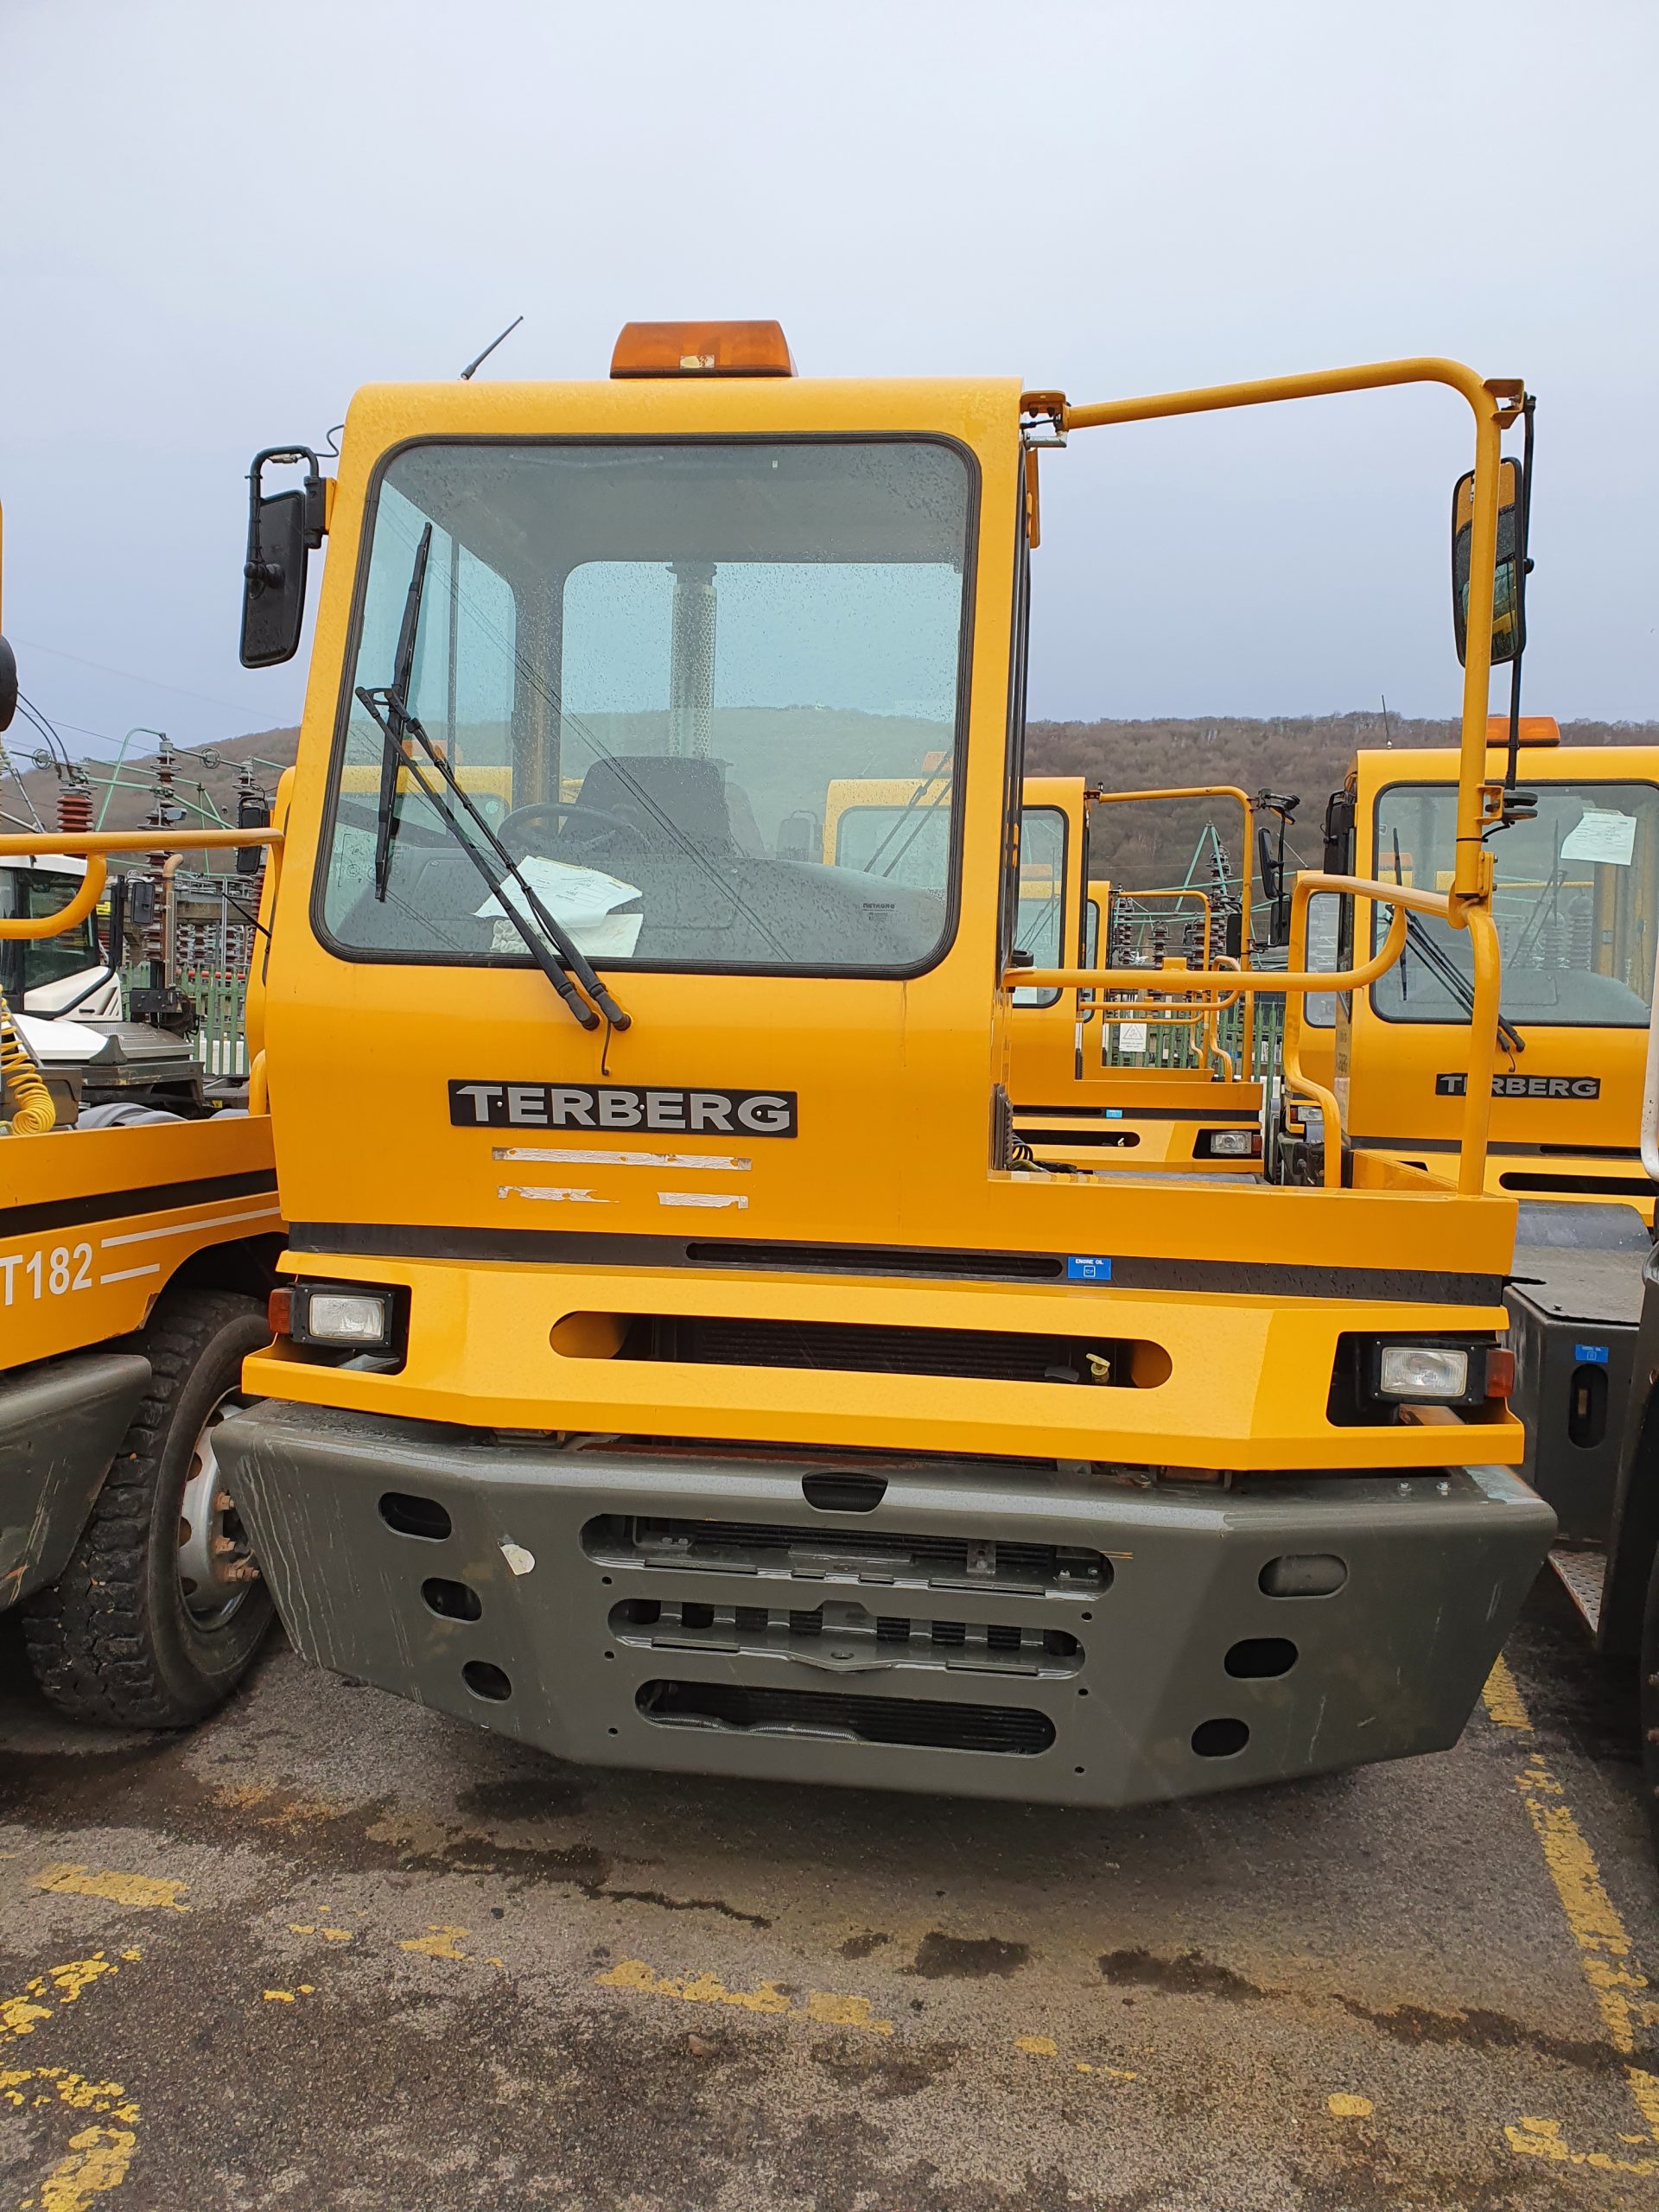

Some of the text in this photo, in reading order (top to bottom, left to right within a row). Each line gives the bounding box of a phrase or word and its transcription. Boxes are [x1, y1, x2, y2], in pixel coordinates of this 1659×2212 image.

[456, 1085, 791, 1132] TERBERG
[1440, 1076, 1597, 1096] TRBERG
[0, 1243, 92, 1306] T182
